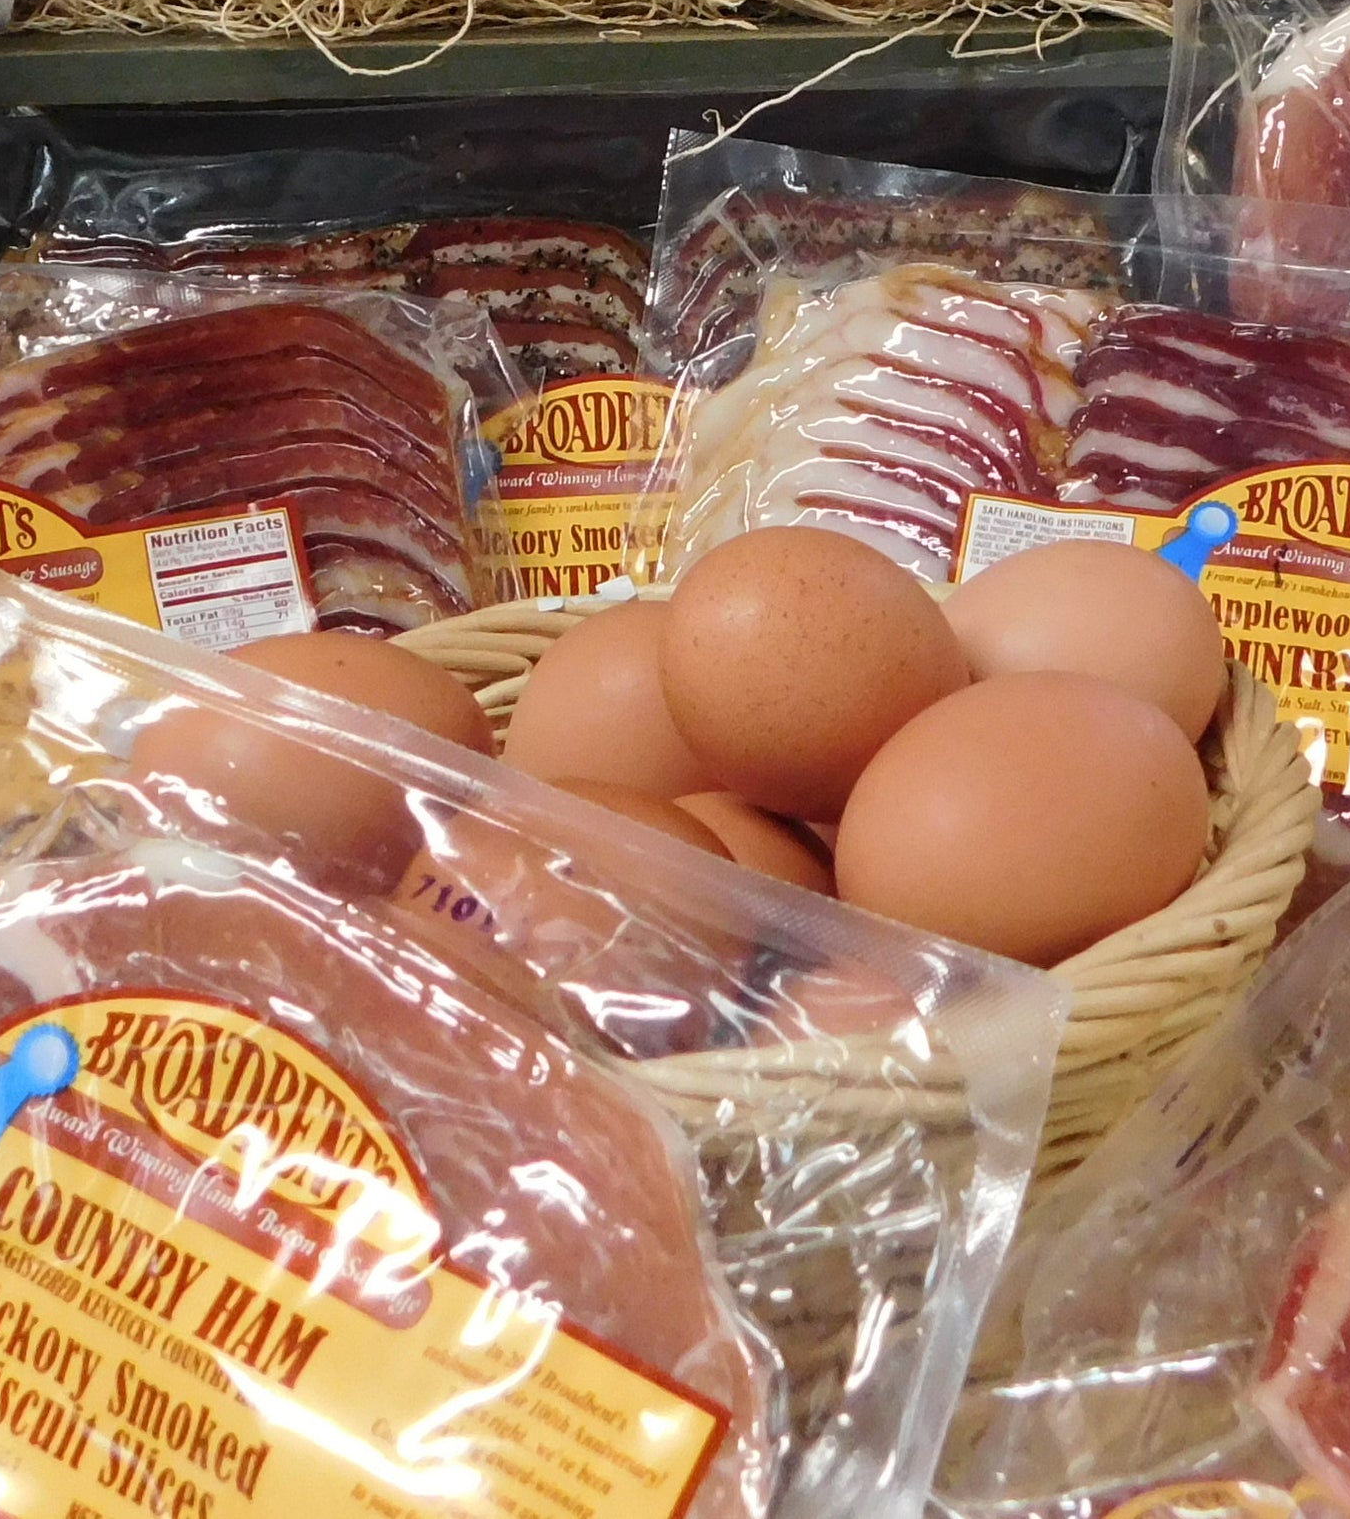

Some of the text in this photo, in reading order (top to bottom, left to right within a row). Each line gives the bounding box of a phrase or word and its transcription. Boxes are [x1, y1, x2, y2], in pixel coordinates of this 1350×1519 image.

[150, 517, 283, 548] Nutrition Facts
[1213, 541, 1269, 560] Award
[1273, 544, 1345, 573] Winning
[194, 1276, 329, 1390] HAM
[97, 1429, 216, 1519] Slices
[108, 1358, 272, 1502] Smoked
